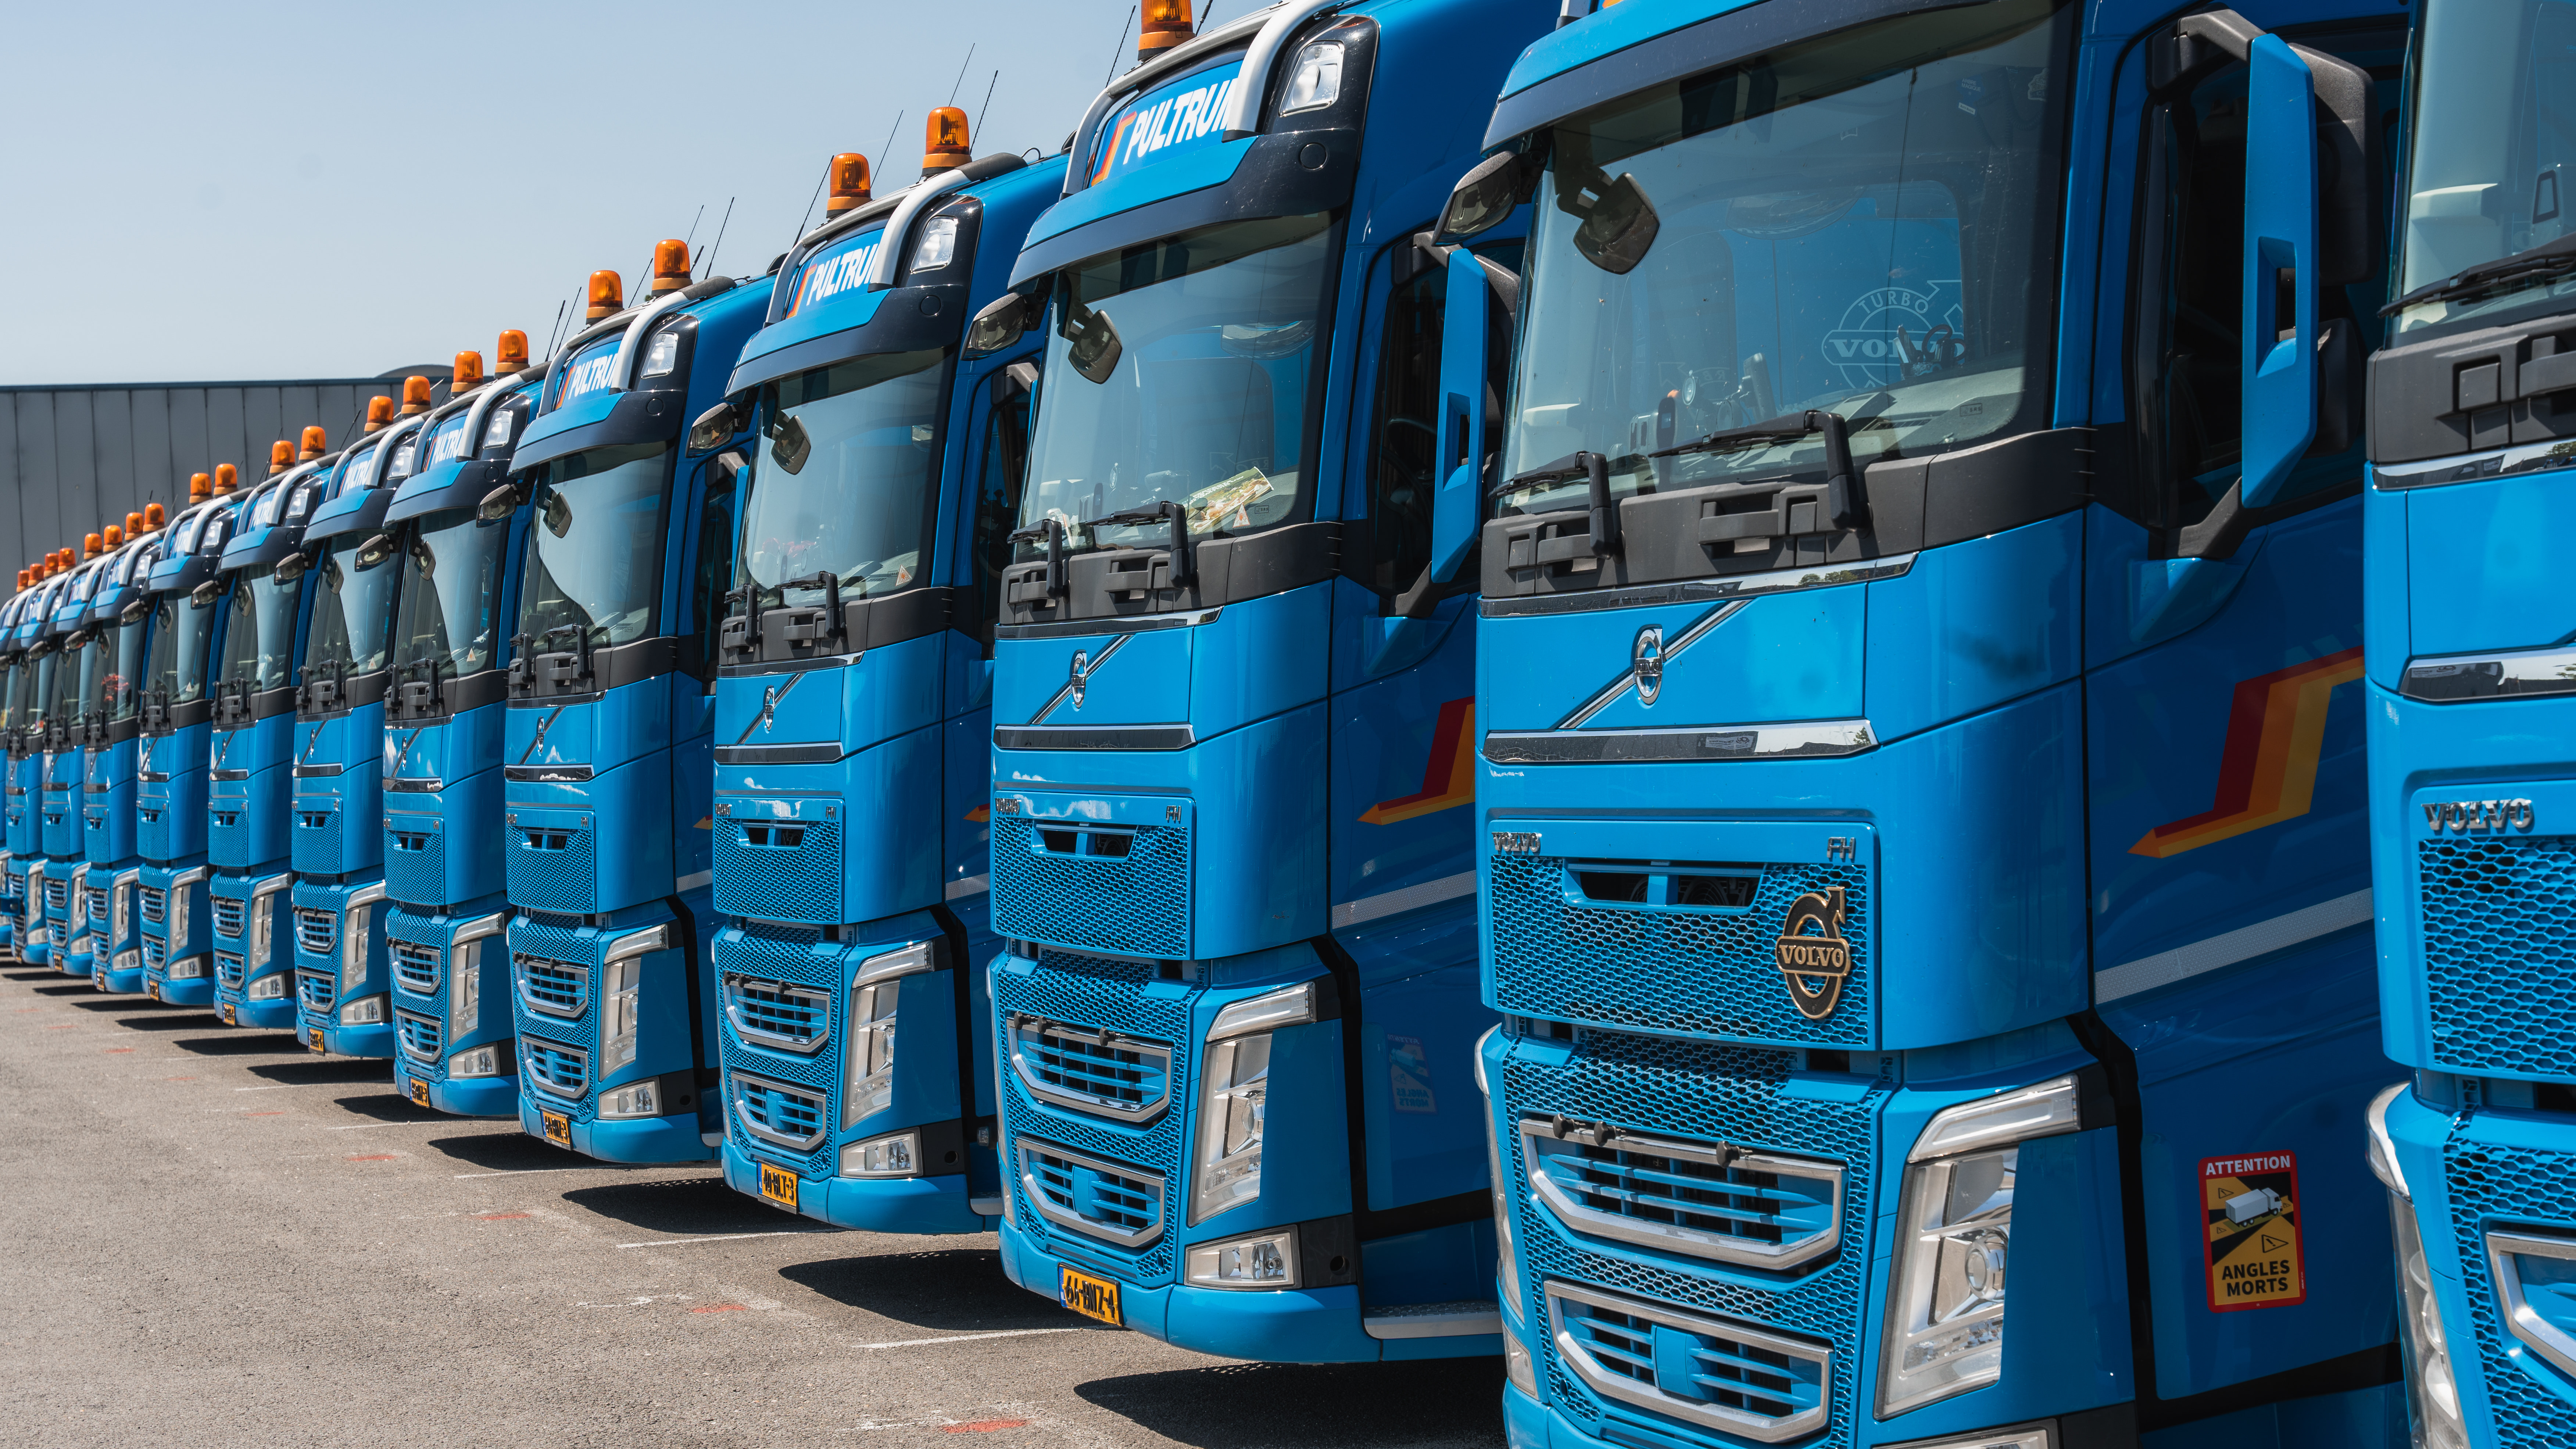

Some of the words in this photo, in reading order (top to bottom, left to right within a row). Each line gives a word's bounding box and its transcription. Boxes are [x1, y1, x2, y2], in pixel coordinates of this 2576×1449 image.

[1961, 83, 1981, 92] MAGIQUE
[806, 243, 879, 306] PULTRU
[1858, 291, 1929, 314] TURBO
[568, 353, 619, 400] PULTRU
[431, 428, 463, 465] PULTRU
[2421, 798, 2533, 831] VOLVO
[1491, 831, 1542, 852] VOLVO
[1827, 837, 1855, 859] FH
[1779, 945, 1844, 967] VOLVO
[2206, 1155, 2291, 1176] ATTENTION
[2222, 1260, 2290, 1280] ANGLES
[1066, 1275, 1115, 1318] 66-BNZ-4
[2227, 1277, 2288, 1297] MORTS
